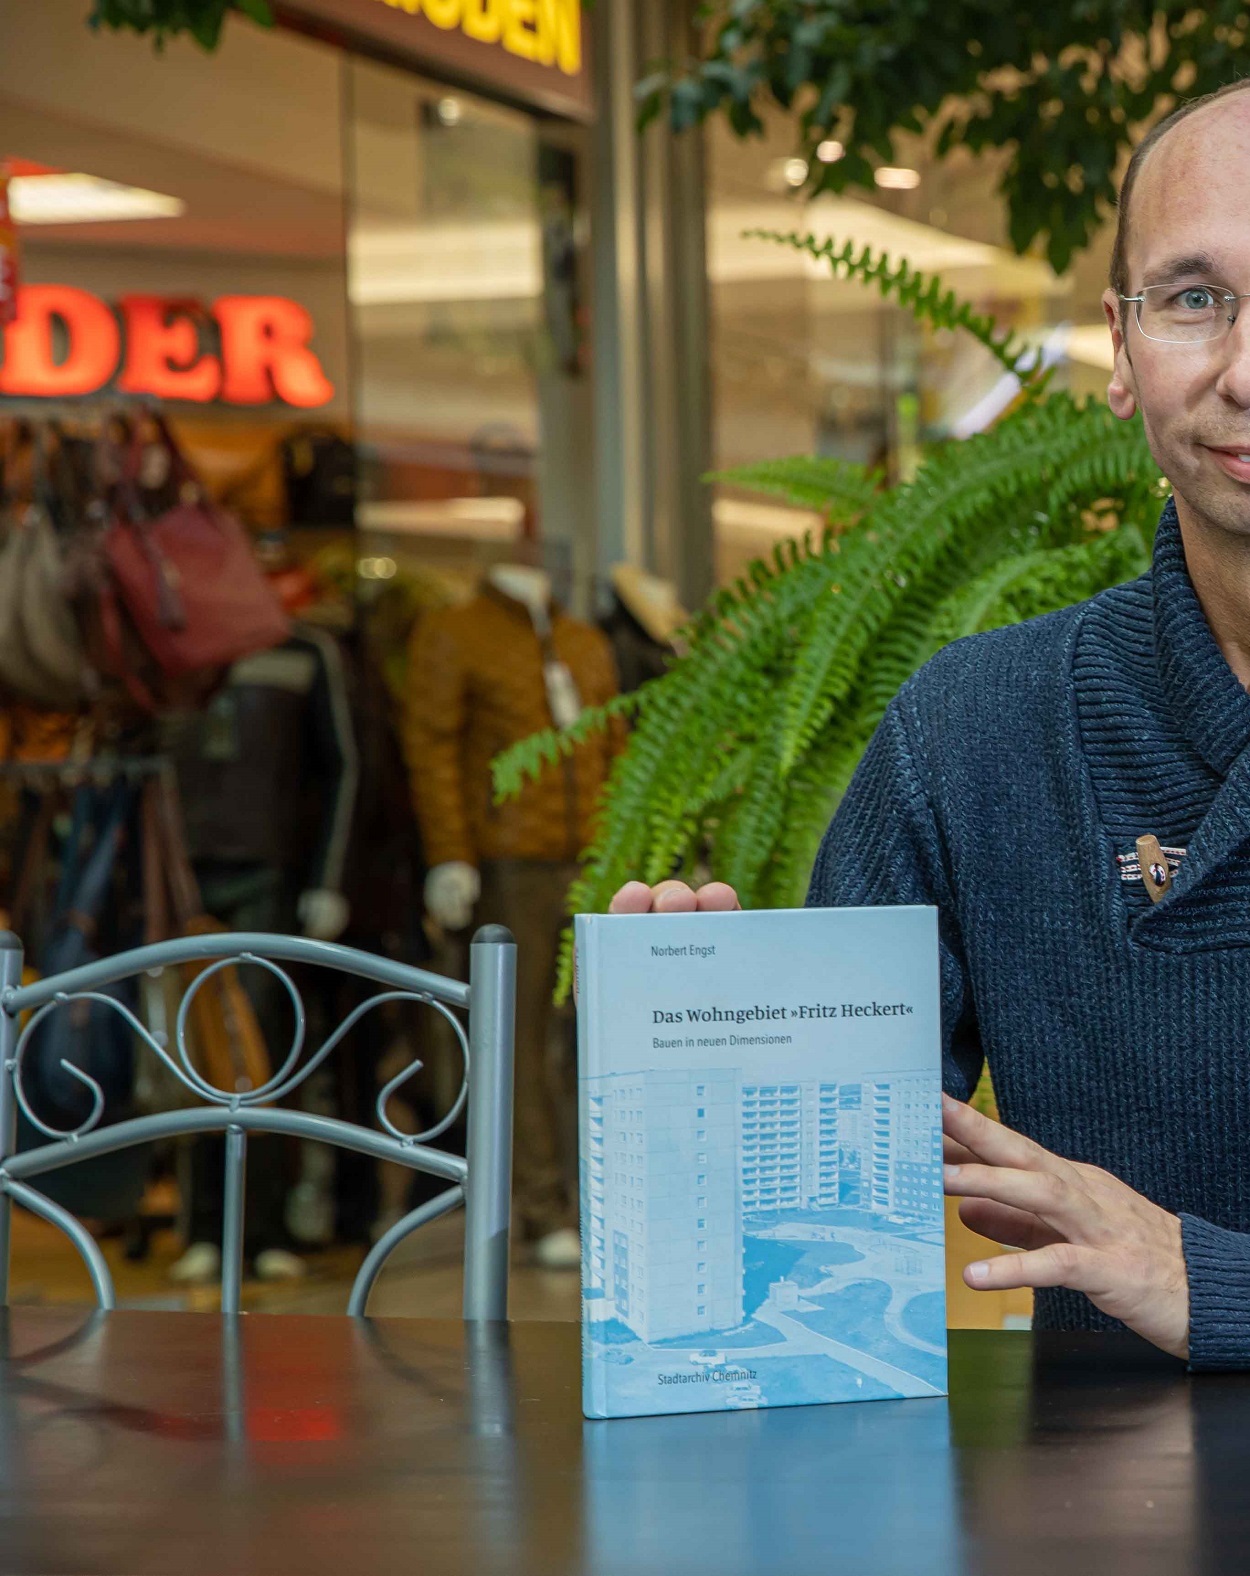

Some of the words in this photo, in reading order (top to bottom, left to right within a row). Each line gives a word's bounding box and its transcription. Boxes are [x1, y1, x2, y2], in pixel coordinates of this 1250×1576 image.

[651, 945, 687, 957] Norbert
[689, 944, 716, 958] Engst
[652, 1010, 683, 1024] Das
[686, 1005, 787, 1024] Wohngebiet
[652, 1037, 682, 1049] Bauen
[685, 1037, 695, 1048] in
[697, 1037, 727, 1047] neuen
[729, 1033, 792, 1046] Dimensionen
[657, 1371, 710, 1385] Stadtarchiv
[712, 1369, 757, 1382] Chemnitz
